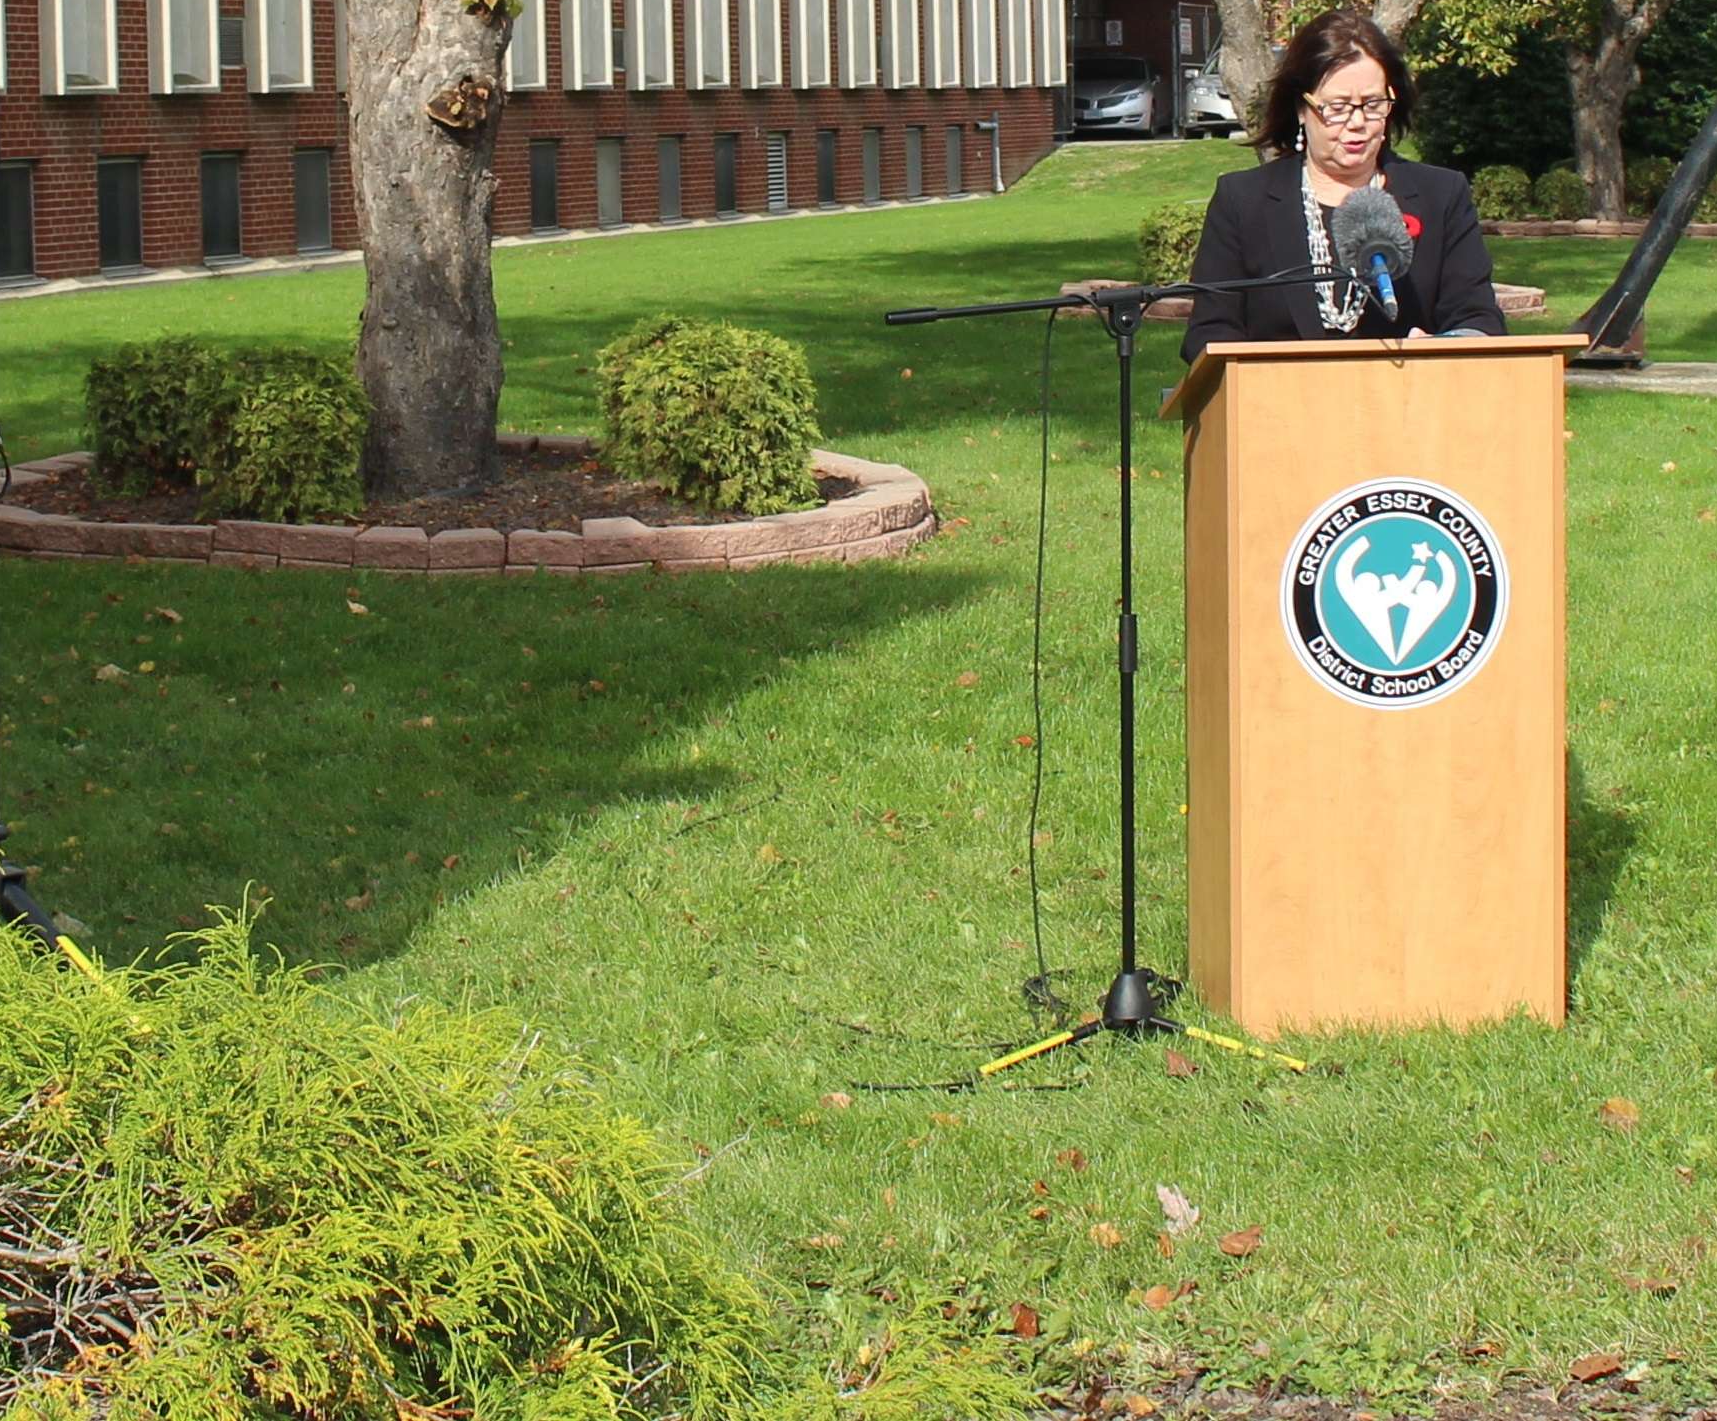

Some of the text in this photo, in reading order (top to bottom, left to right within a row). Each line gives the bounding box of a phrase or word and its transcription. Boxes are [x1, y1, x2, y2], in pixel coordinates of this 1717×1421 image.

[1298, 493, 1492, 586] GREATER ESSEX COUNTY
[1308, 629, 1484, 695] District School Board
